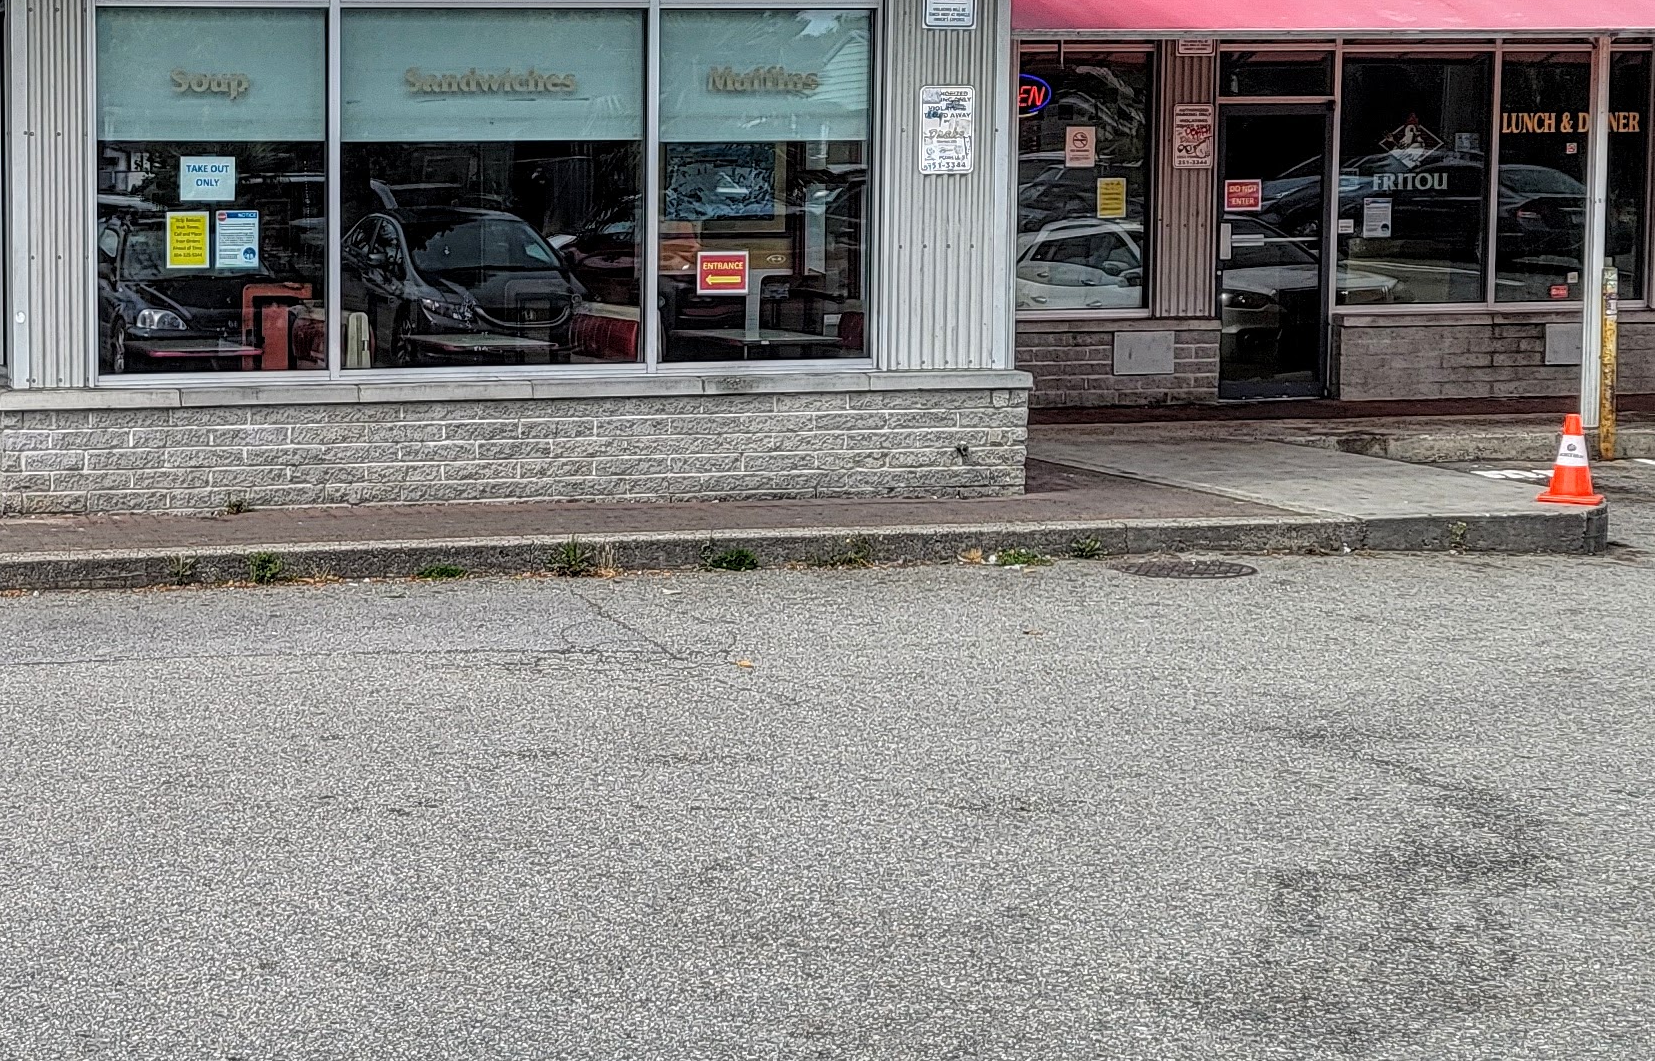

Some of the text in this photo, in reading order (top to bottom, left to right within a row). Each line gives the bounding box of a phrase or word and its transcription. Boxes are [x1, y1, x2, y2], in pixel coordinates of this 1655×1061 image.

[170, 67, 250, 101] Soup
[404, 65, 576, 93] Sandwiches
[707, 65, 819, 92] Muffins
[1018, 85, 1046, 107] EN
[1502, 111, 1640, 134] LUNCH & DNER
[186, 164, 230, 173] TAKE OUT
[195, 178, 220, 187] ONLY
[1229, 184, 1257, 193] DO NOT
[1373, 172, 1448, 191] FRITOU
[1231, 197, 1255, 205] ENTER
[702, 261, 744, 270] ENTRANCE
